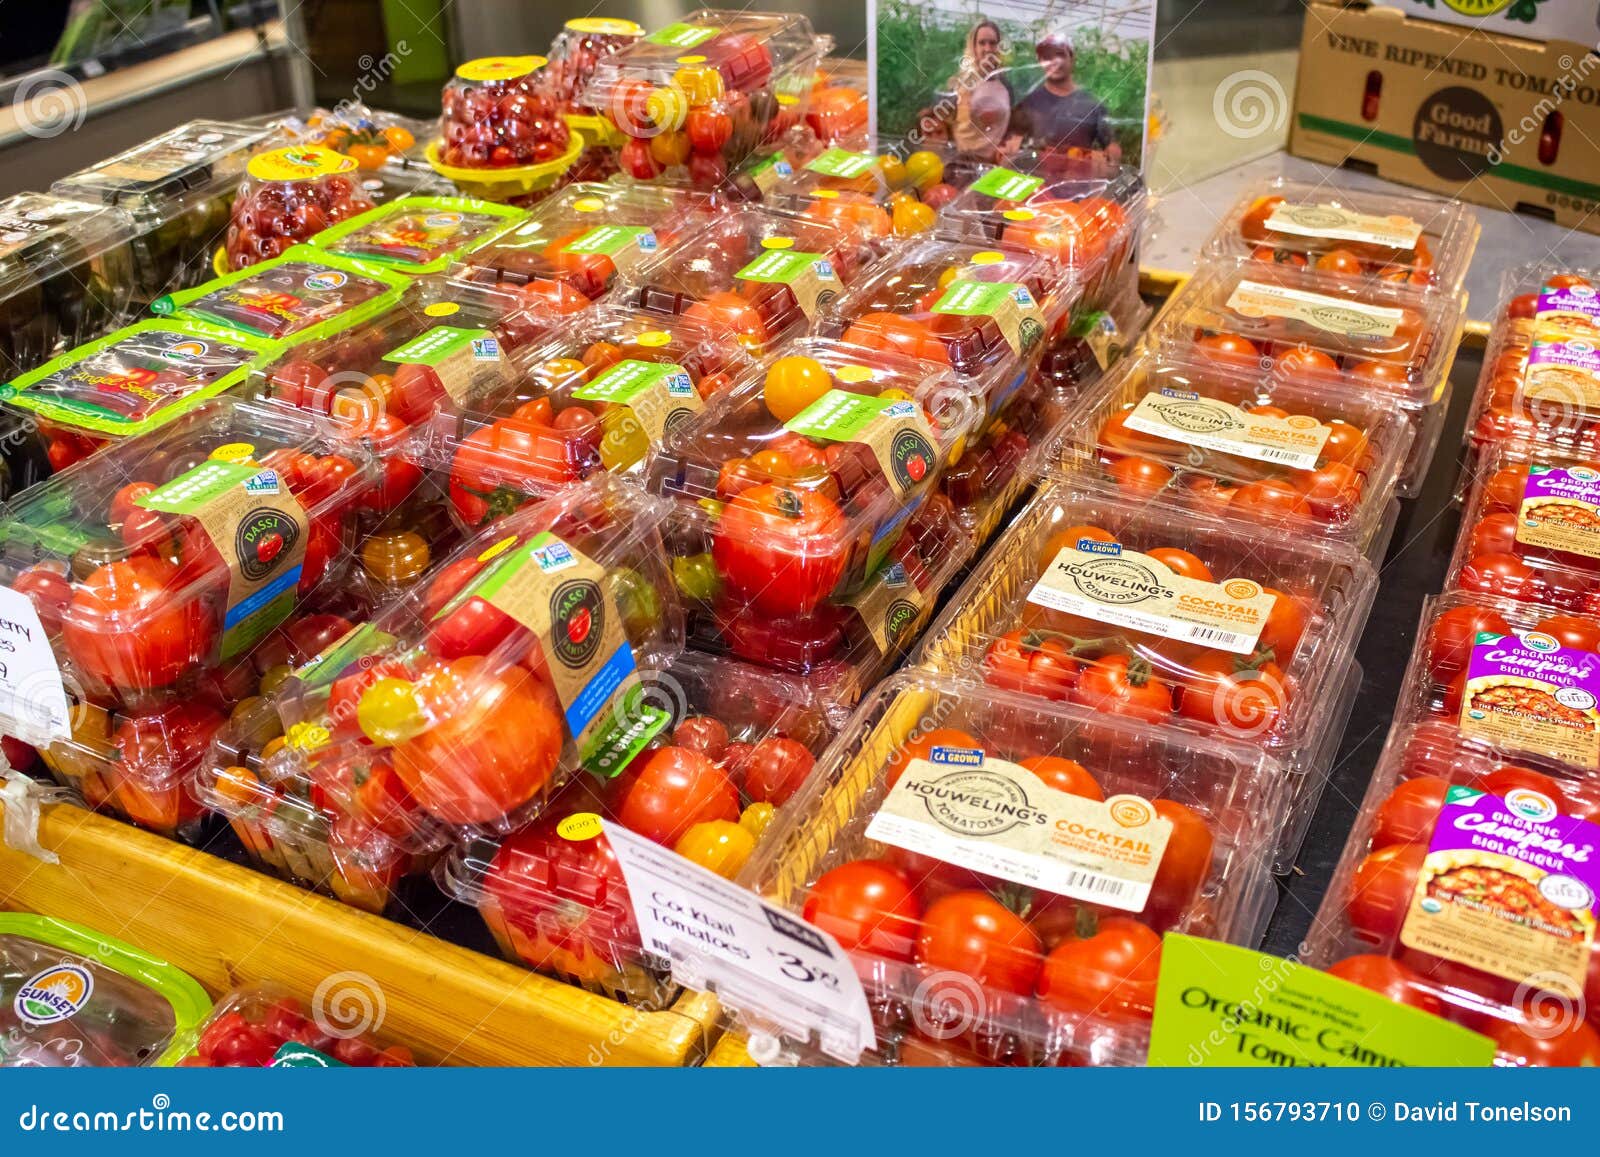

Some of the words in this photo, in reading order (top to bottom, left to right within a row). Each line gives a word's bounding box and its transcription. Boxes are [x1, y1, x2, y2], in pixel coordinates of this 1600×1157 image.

[1327, 33, 1378, 58] VINE
[1384, 43, 1488, 81] RIPENED
[1430, 103, 1491, 133] Good
[1420, 122, 1492, 157] Farms
[71, 371, 118, 387] Angel
[119, 381, 162, 403] Sweet
[583, 362, 637, 395] Tomato
[1146, 402, 1246, 430] HOUWELING'S
[1249, 425, 1318, 442] COCKTAIL
[895, 439, 919, 460] DASSI
[148, 464, 221, 504] Tomato
[164, 468, 231, 505] Lovers
[244, 518, 280, 544] DASSI
[1081, 542, 1092, 552] CA
[1093, 544, 1119, 556] GROWN
[1057, 562, 1175, 599] HOUWELING'S
[1082, 580, 1140, 601] TOMATOES
[560, 588, 588, 620] DASSI
[889, 599, 911, 633] DASSI
[1179, 594, 1260, 617] COCKTAIL
[0, 618, 32, 643] erry
[1484, 650, 1593, 679] Campari
[1512, 648, 1565, 664] ORGANIC
[1499, 664, 1576, 688] BIOLOGIQUE
[1493, 706, 1523, 718] TOMATO
[1553, 719, 1585, 729] TOMATO
[599, 715, 656, 767] Tomato
[933, 751, 946, 763] CA
[947, 752, 981, 765] GROWN
[904, 780, 1049, 826] HOUWELING'S
[936, 802, 1004, 829] TOMATOES
[564, 817, 598, 834] Local
[1054, 818, 1153, 856] COCKTAIL
[1453, 813, 1594, 863] Campari
[1491, 812, 1561, 839] ORGANIC
[651, 892, 736, 937] Cocktail
[651, 906, 751, 960] Tomatoes
[19, 987, 78, 1017] SUNSET
[1180, 986, 1311, 1042] Organic
[1233, 1031, 1329, 1067] Tom
